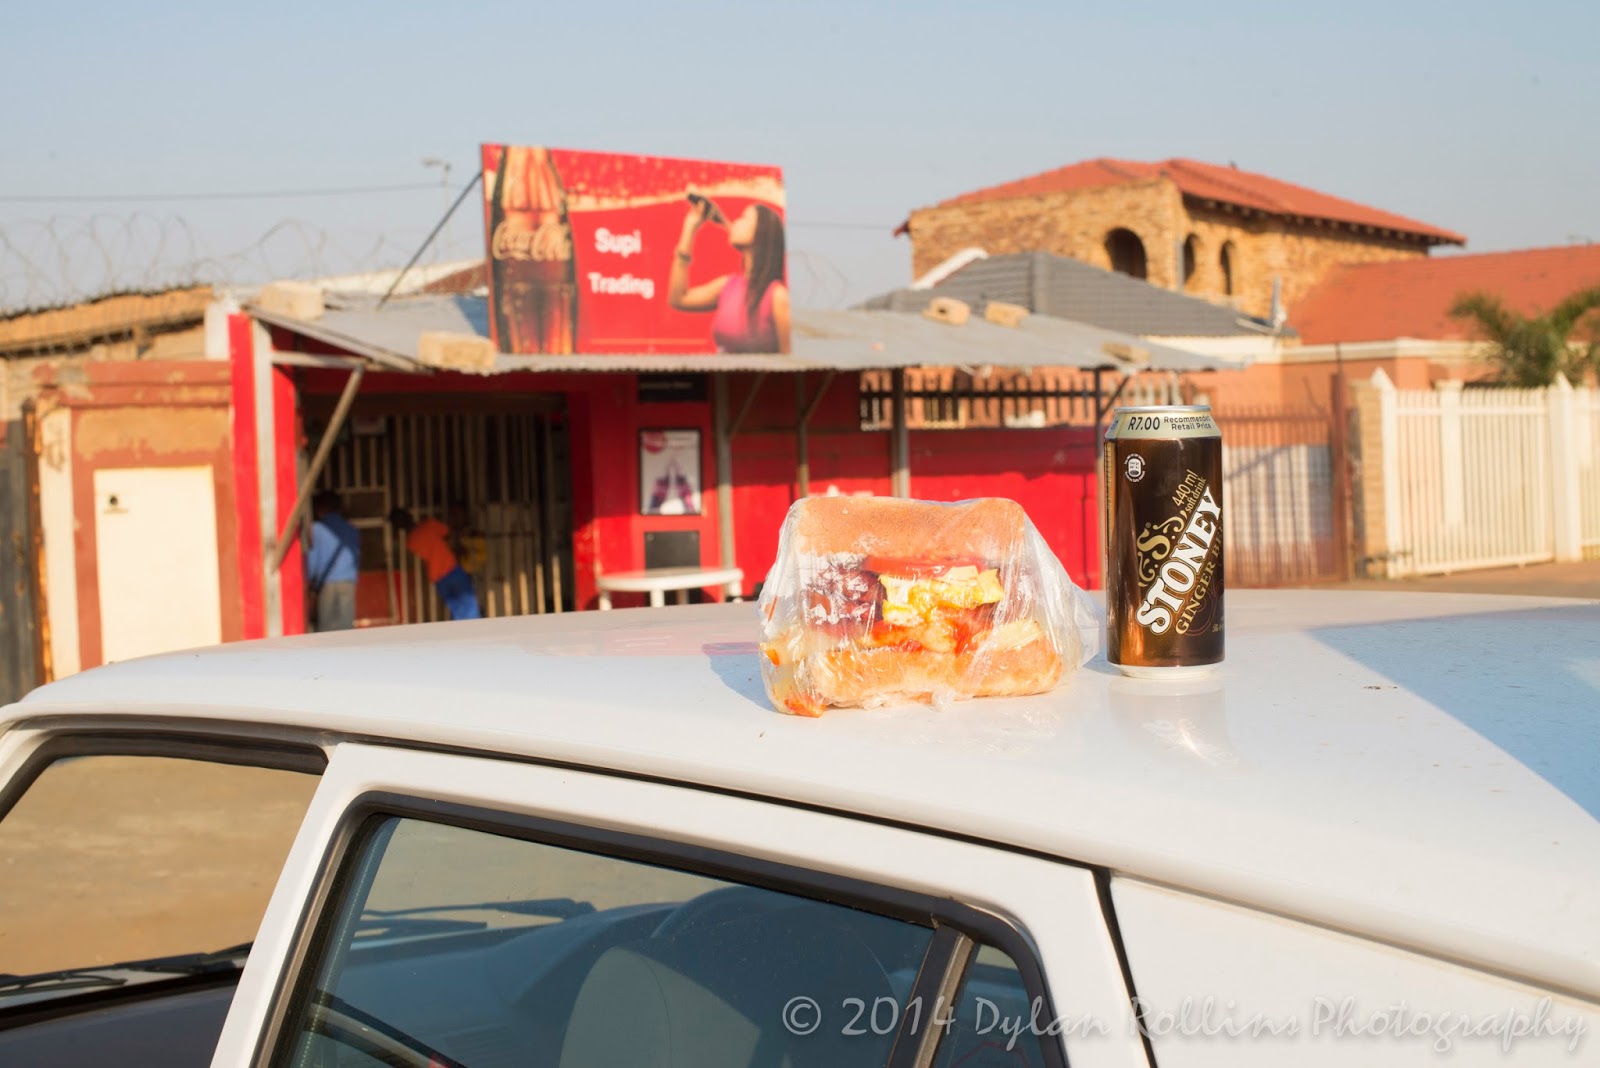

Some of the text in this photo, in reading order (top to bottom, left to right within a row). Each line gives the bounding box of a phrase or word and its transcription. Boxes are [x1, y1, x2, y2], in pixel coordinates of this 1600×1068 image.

[588, 273, 655, 299] Trading
[1127, 416, 1160, 431] R7.00
[1172, 469, 1198, 506] 440 ml
[1185, 477, 1207, 513] soft drink
[1136, 486, 1221, 634] STONEY
[1175, 561, 1216, 634] GINGER
